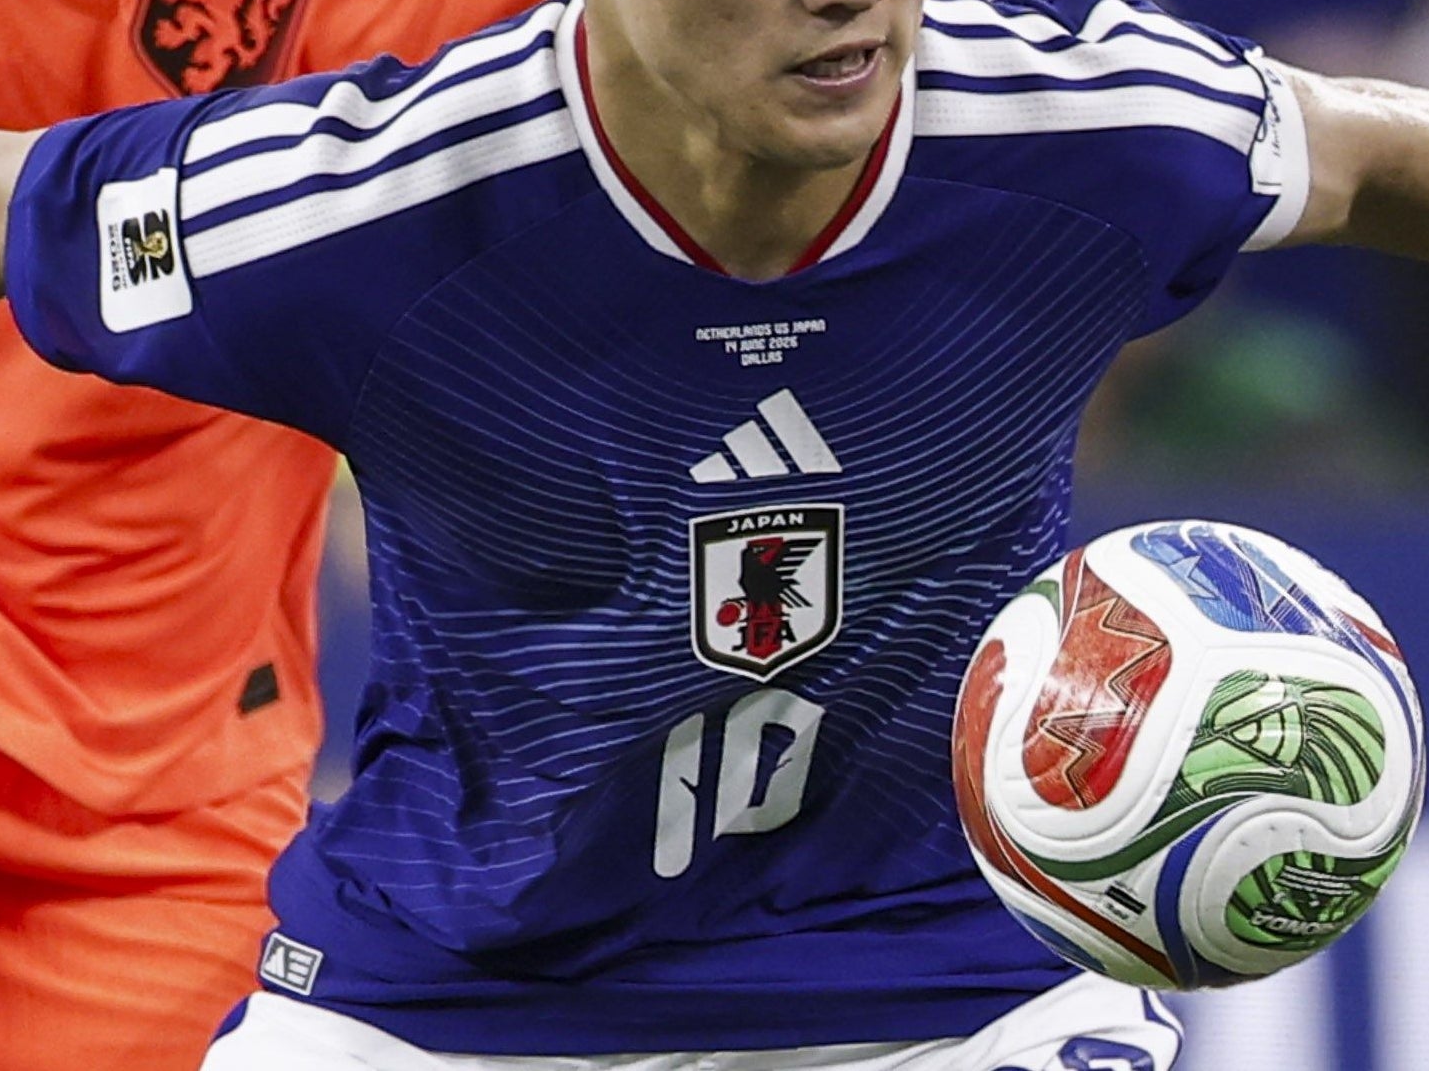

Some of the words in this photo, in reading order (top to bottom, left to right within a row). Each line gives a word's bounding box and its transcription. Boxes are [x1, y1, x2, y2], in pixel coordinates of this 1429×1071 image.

[792, 318, 826, 333] JAPAN
[740, 338, 766, 351] JUNE
[741, 350, 783, 366] DALLAS
[727, 512, 804, 533] JAPAN
[653, 688, 826, 878] 10
